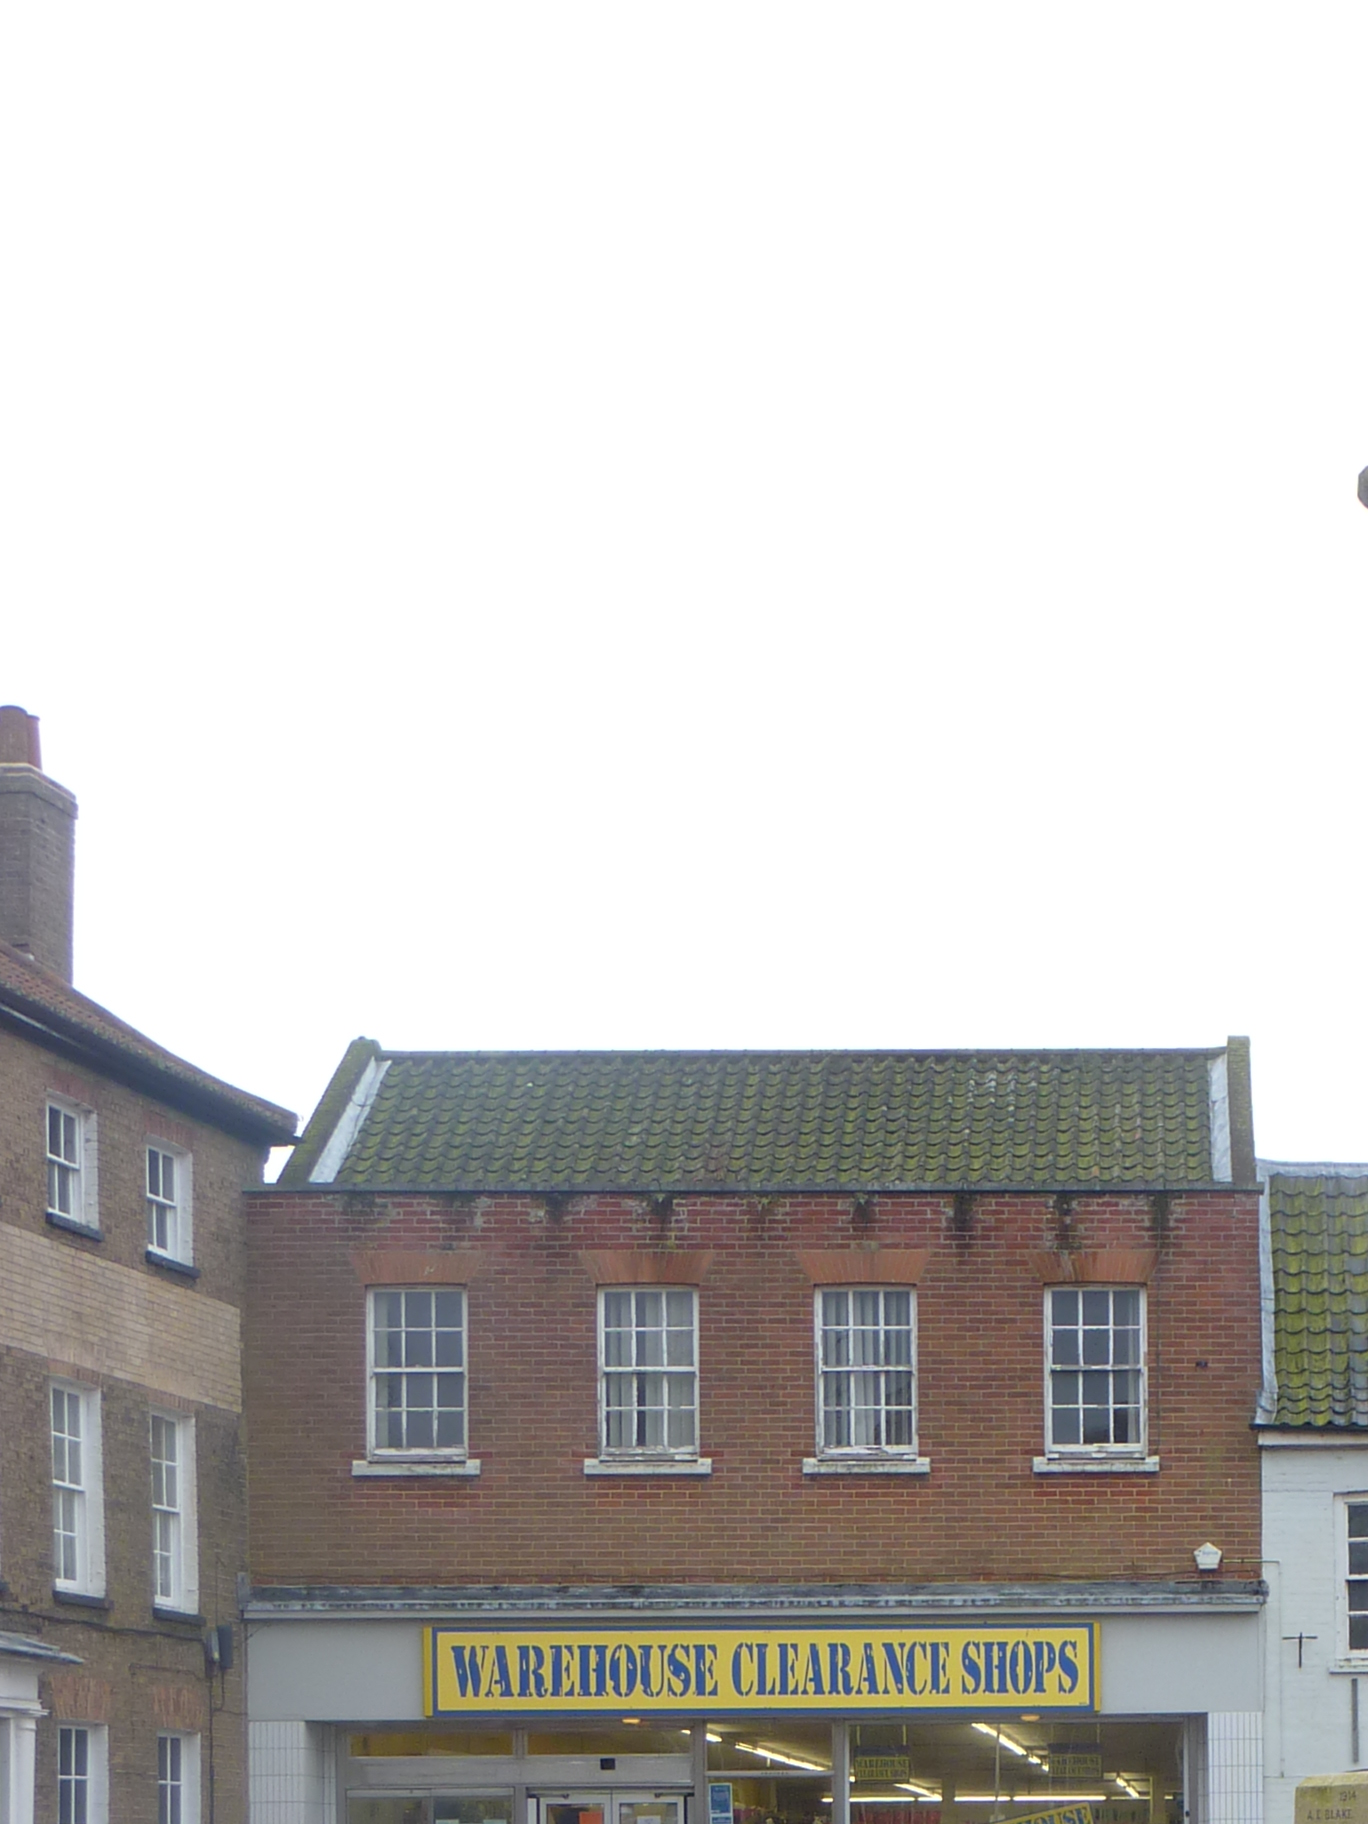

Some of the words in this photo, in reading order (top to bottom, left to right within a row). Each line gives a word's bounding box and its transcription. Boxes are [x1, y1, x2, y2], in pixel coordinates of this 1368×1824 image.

[451, 1644, 719, 1698] WAREHOUSE
[731, 1641, 950, 1697] CLEARANCE
[961, 1640, 1078, 1695] SHOPS
